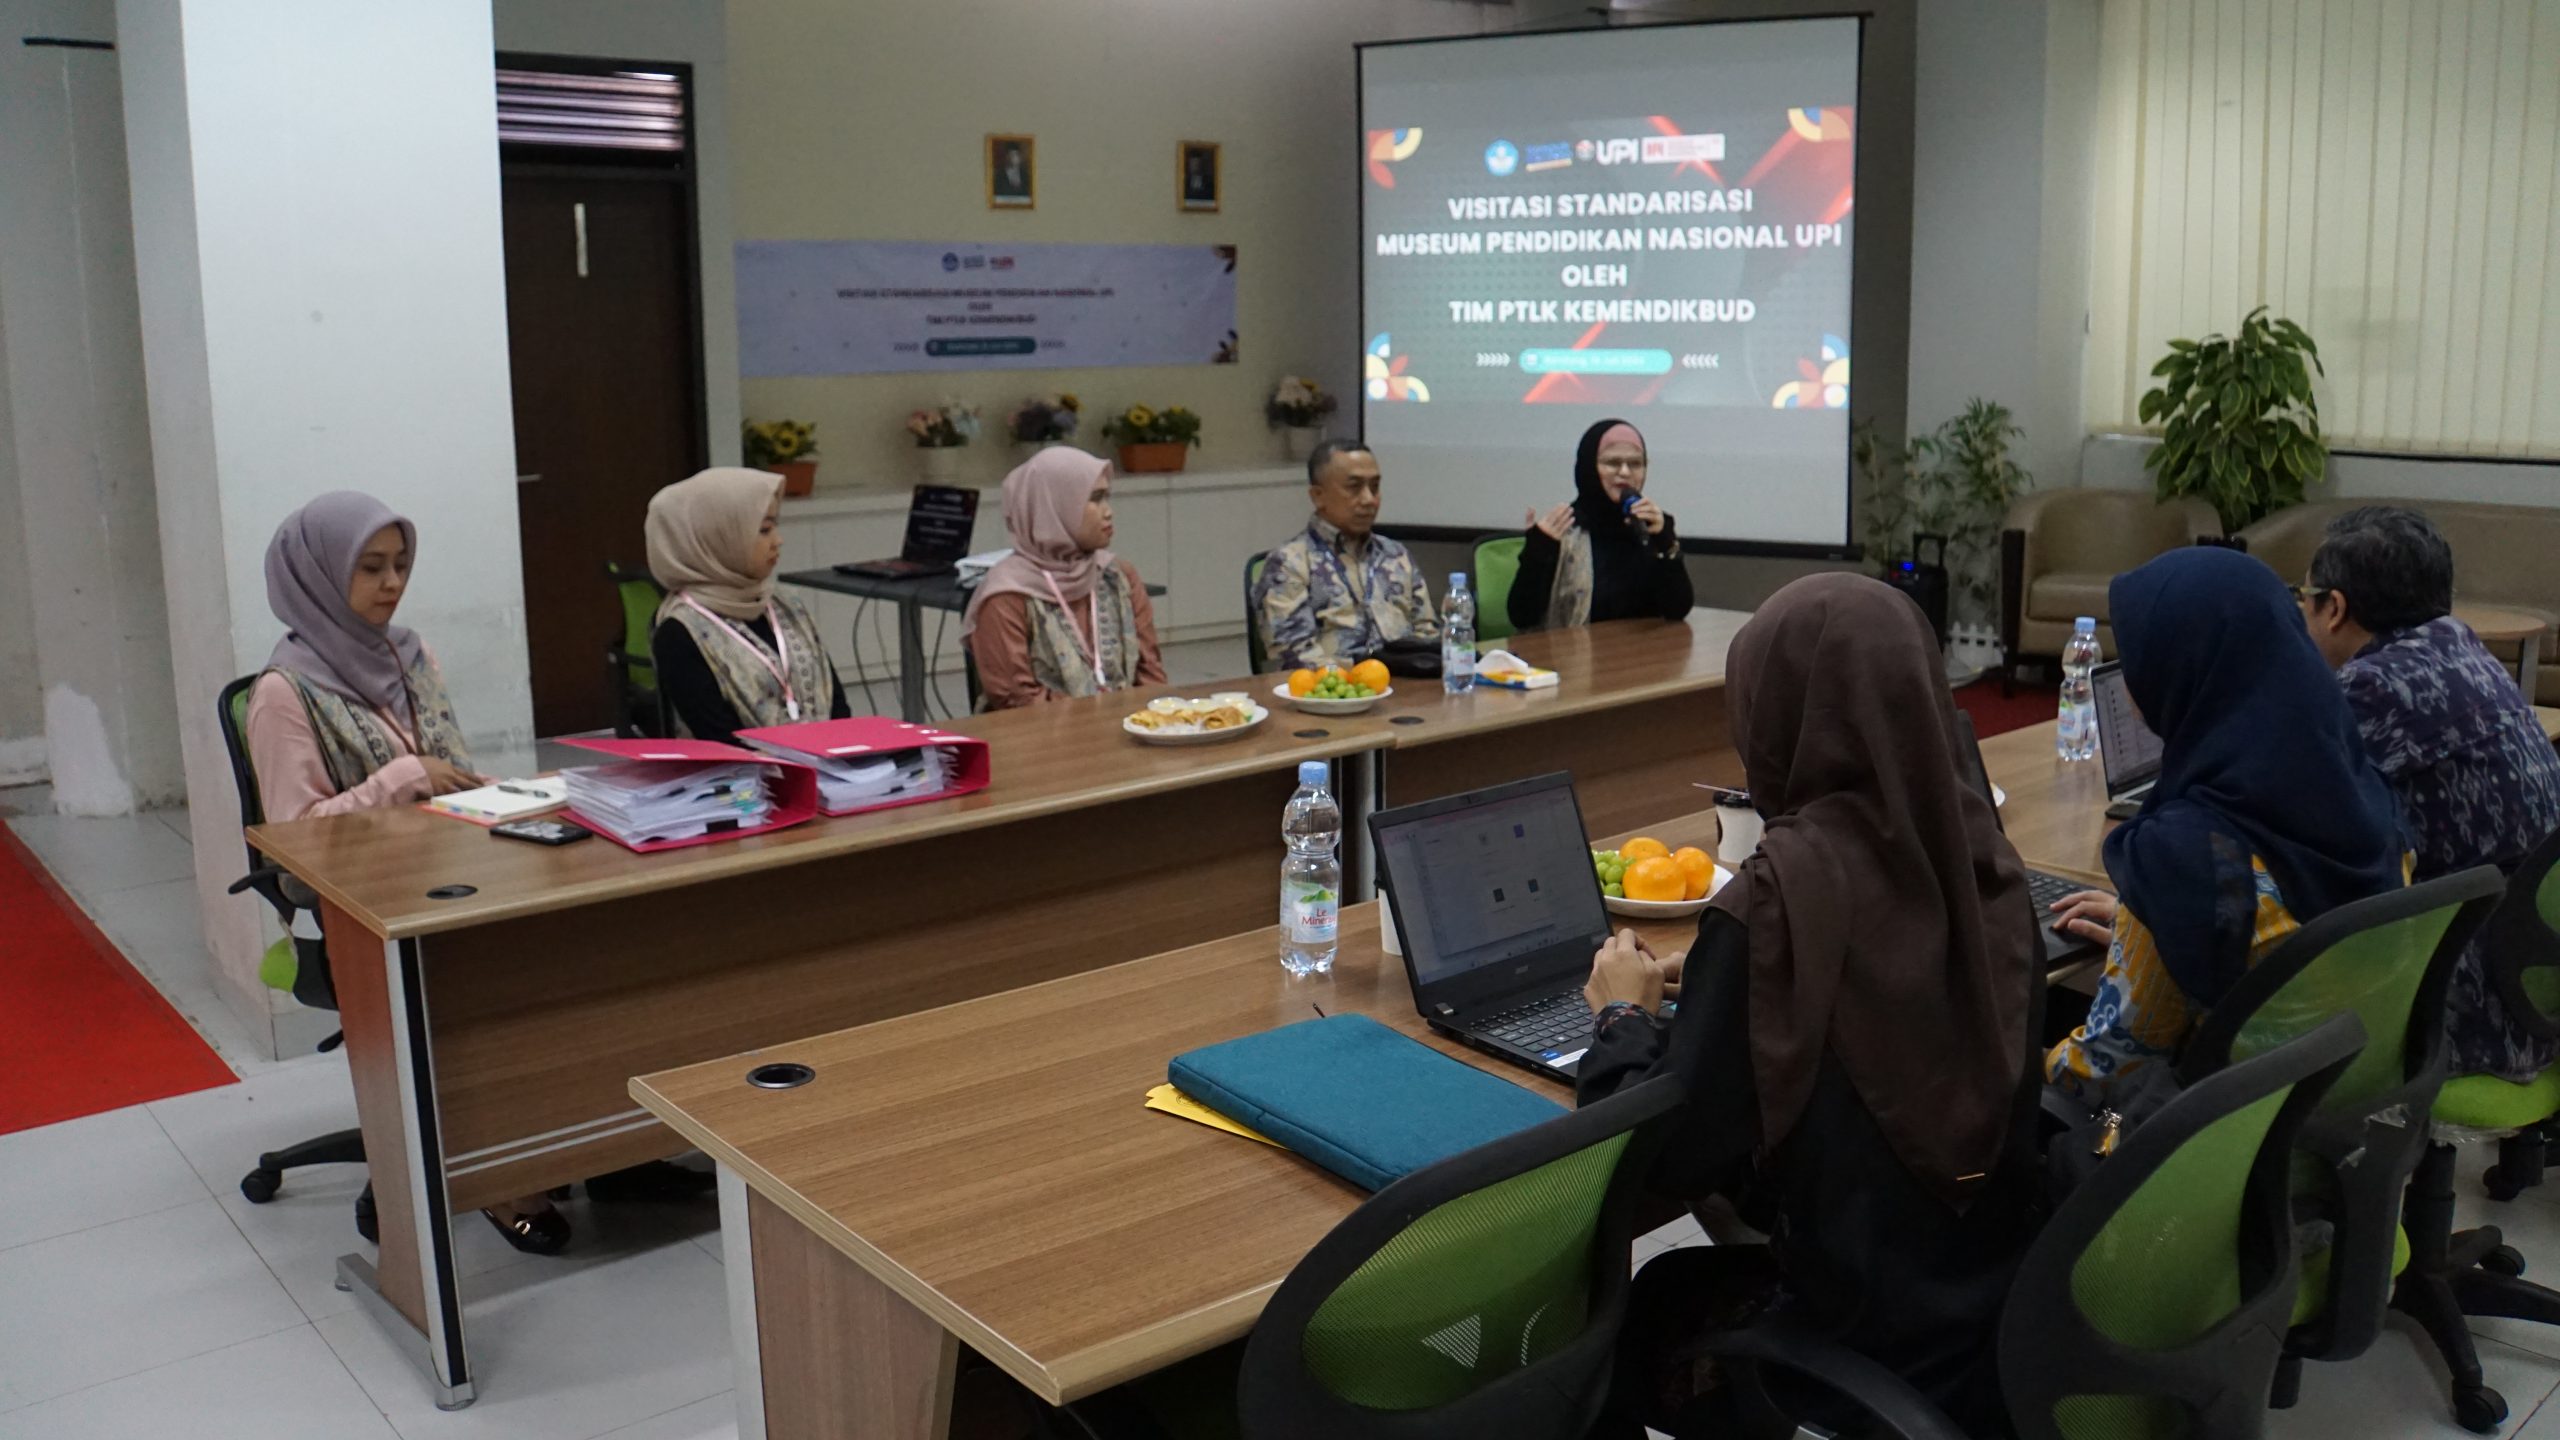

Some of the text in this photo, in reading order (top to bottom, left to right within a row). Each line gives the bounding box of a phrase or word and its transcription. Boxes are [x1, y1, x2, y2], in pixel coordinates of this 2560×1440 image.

[1596, 138, 1639, 165] UPI
[1448, 188, 1753, 220] VISITASI STANDARISASI
[1376, 223, 1842, 256] MUSEUM PENDIDIKAN NASIONAL UPI
[1561, 264, 1628, 288] OLEH
[1449, 299, 1756, 323] TIM PTLK KEMENDIKBUD
[1316, 907, 1328, 917] Le
